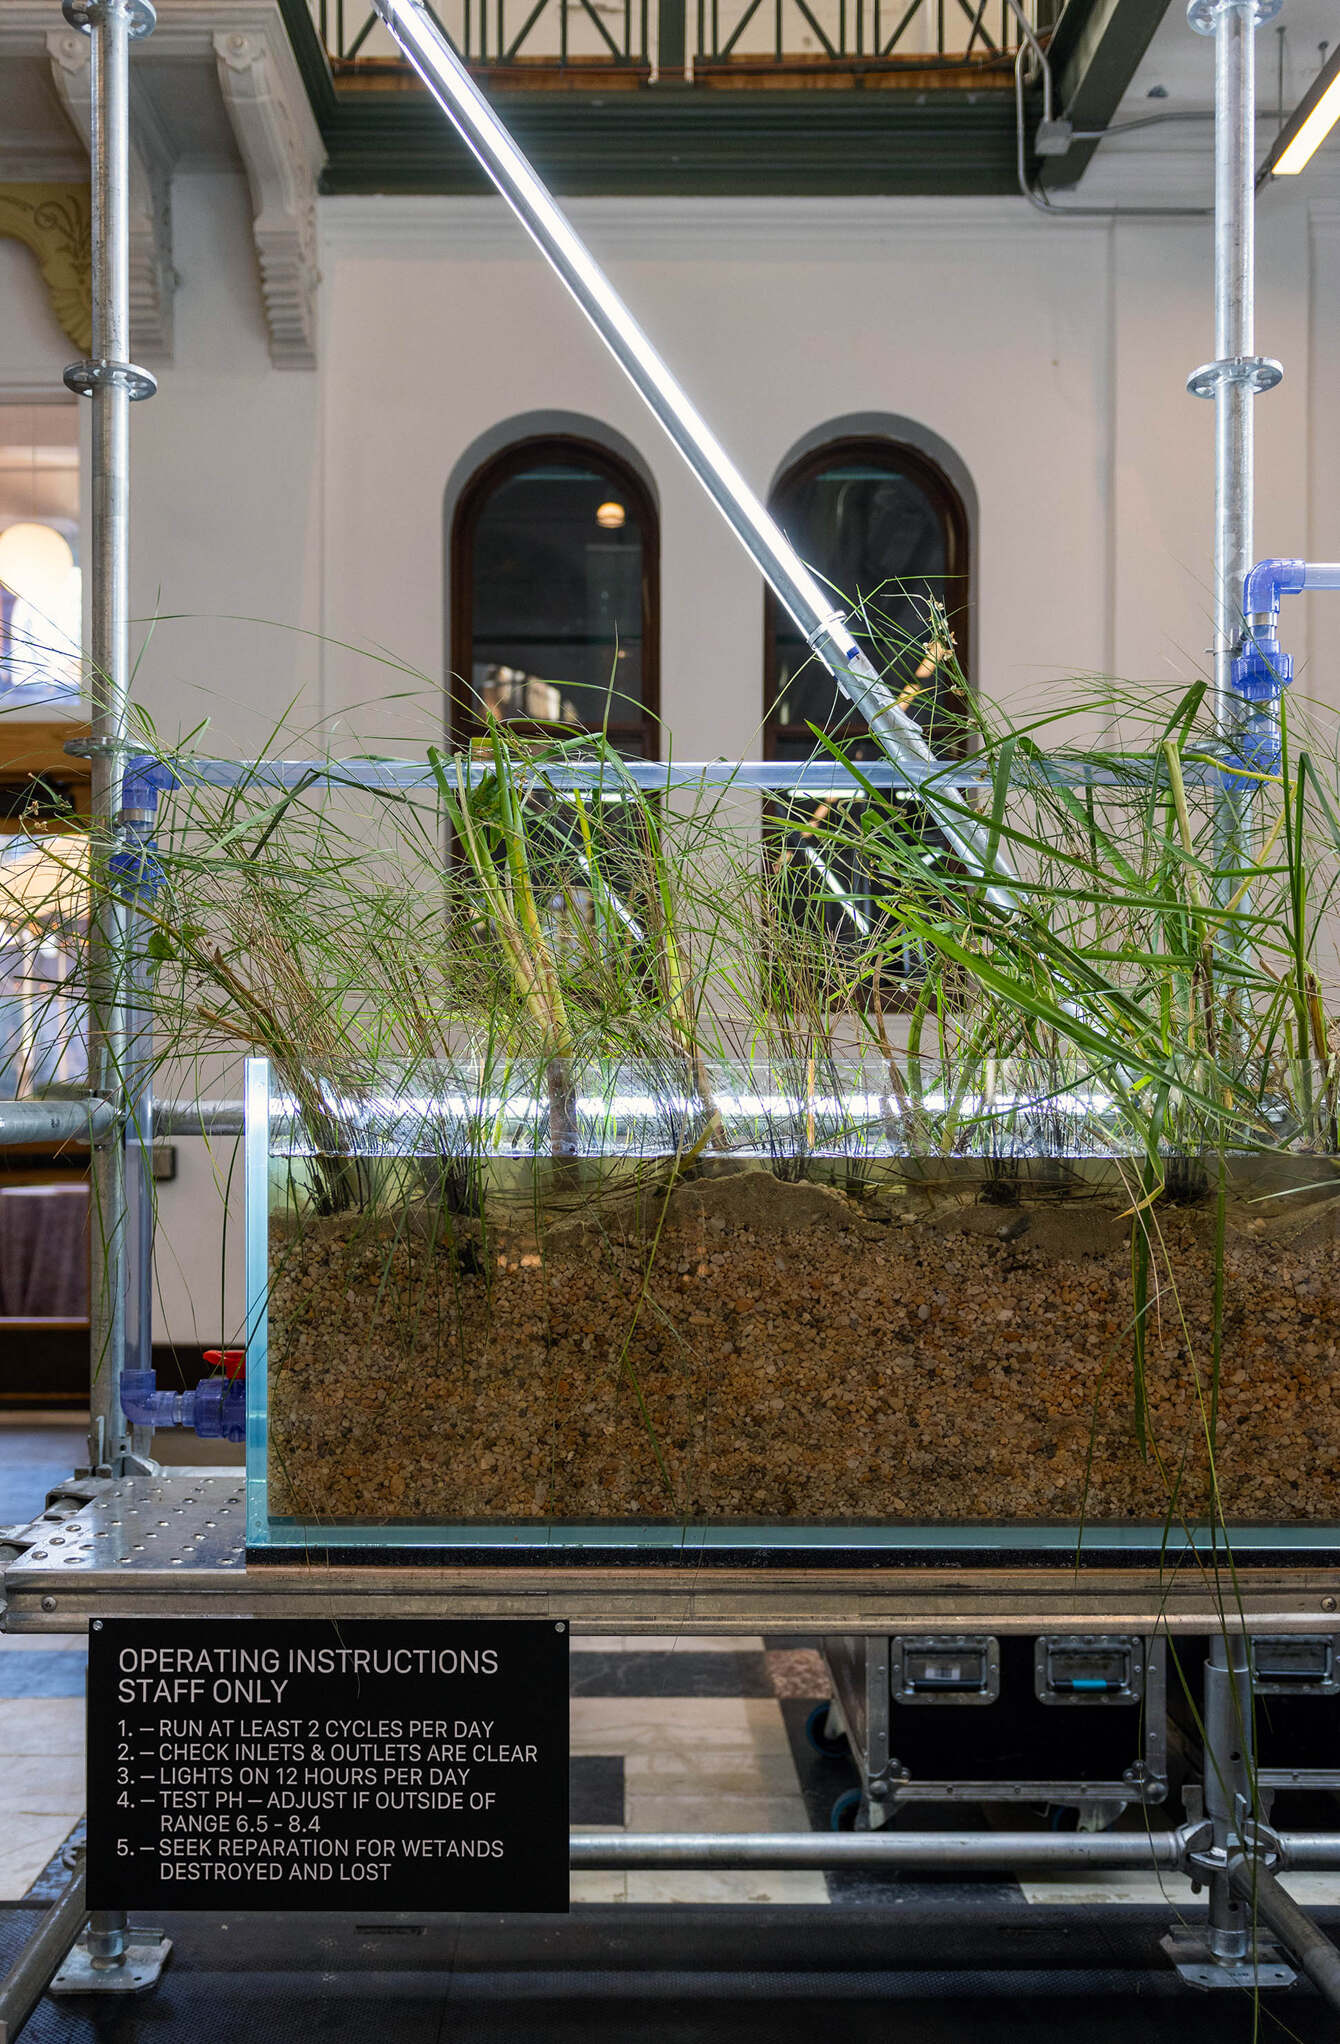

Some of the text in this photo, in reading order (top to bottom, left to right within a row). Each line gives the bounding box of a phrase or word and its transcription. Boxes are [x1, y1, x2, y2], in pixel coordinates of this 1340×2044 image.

[119, 1647, 499, 1675] OPERATING INSTRUCTIONS
[118, 1678, 289, 1704] STAFF ONLY
[117, 1719, 133, 1737] 1.
[159, 1719, 203, 1737] RUN
[208, 1719, 235, 1737] AT
[240, 1719, 303, 1738] LEAST
[308, 1719, 320, 1738] 2
[325, 1719, 403, 1738] CYCLES
[409, 1720, 448, 1738] PER
[454, 1720, 495, 1739] DAY
[117, 1743, 135, 1761] 2.
[159, 1743, 230, 1761] CHECK
[235, 1743, 305, 1762] INLETS
[310, 1743, 326, 1762] &
[330, 1743, 422, 1762] OUTLETS
[426, 1744, 467, 1762] ARE
[472, 1744, 538, 1763] CLEAR
[116, 1766, 135, 1785] 3.
[160, 1766, 233, 1785] LIGHTS
[239, 1767, 269, 1785] ON
[276, 1767, 298, 1785] 12
[304, 1767, 377, 1786] HOURS
[384, 1767, 423, 1786] PER
[429, 1767, 471, 1786] DAY
[116, 1790, 135, 1809] 4.
[159, 1790, 211, 1809] TEST
[215, 1790, 243, 1809] PH
[266, 1791, 348, 1809] ADJUST
[353, 1791, 370, 1809] IF
[375, 1791, 464, 1810] OUTSIDE
[469, 1791, 496, 1810] OF
[160, 1814, 231, 1833] RANGE
[236, 1814, 269, 1833] 6.5
[288, 1814, 321, 1833] 8.4
[116, 1838, 135, 1857] 5.
[159, 1838, 212, 1857] SEEK
[218, 1838, 349, 1857] REPARATION
[355, 1839, 396, 1857] FOR
[401, 1839, 504, 1858] WETANDS
[160, 1862, 392, 1881] DESTROYED AND LOST
